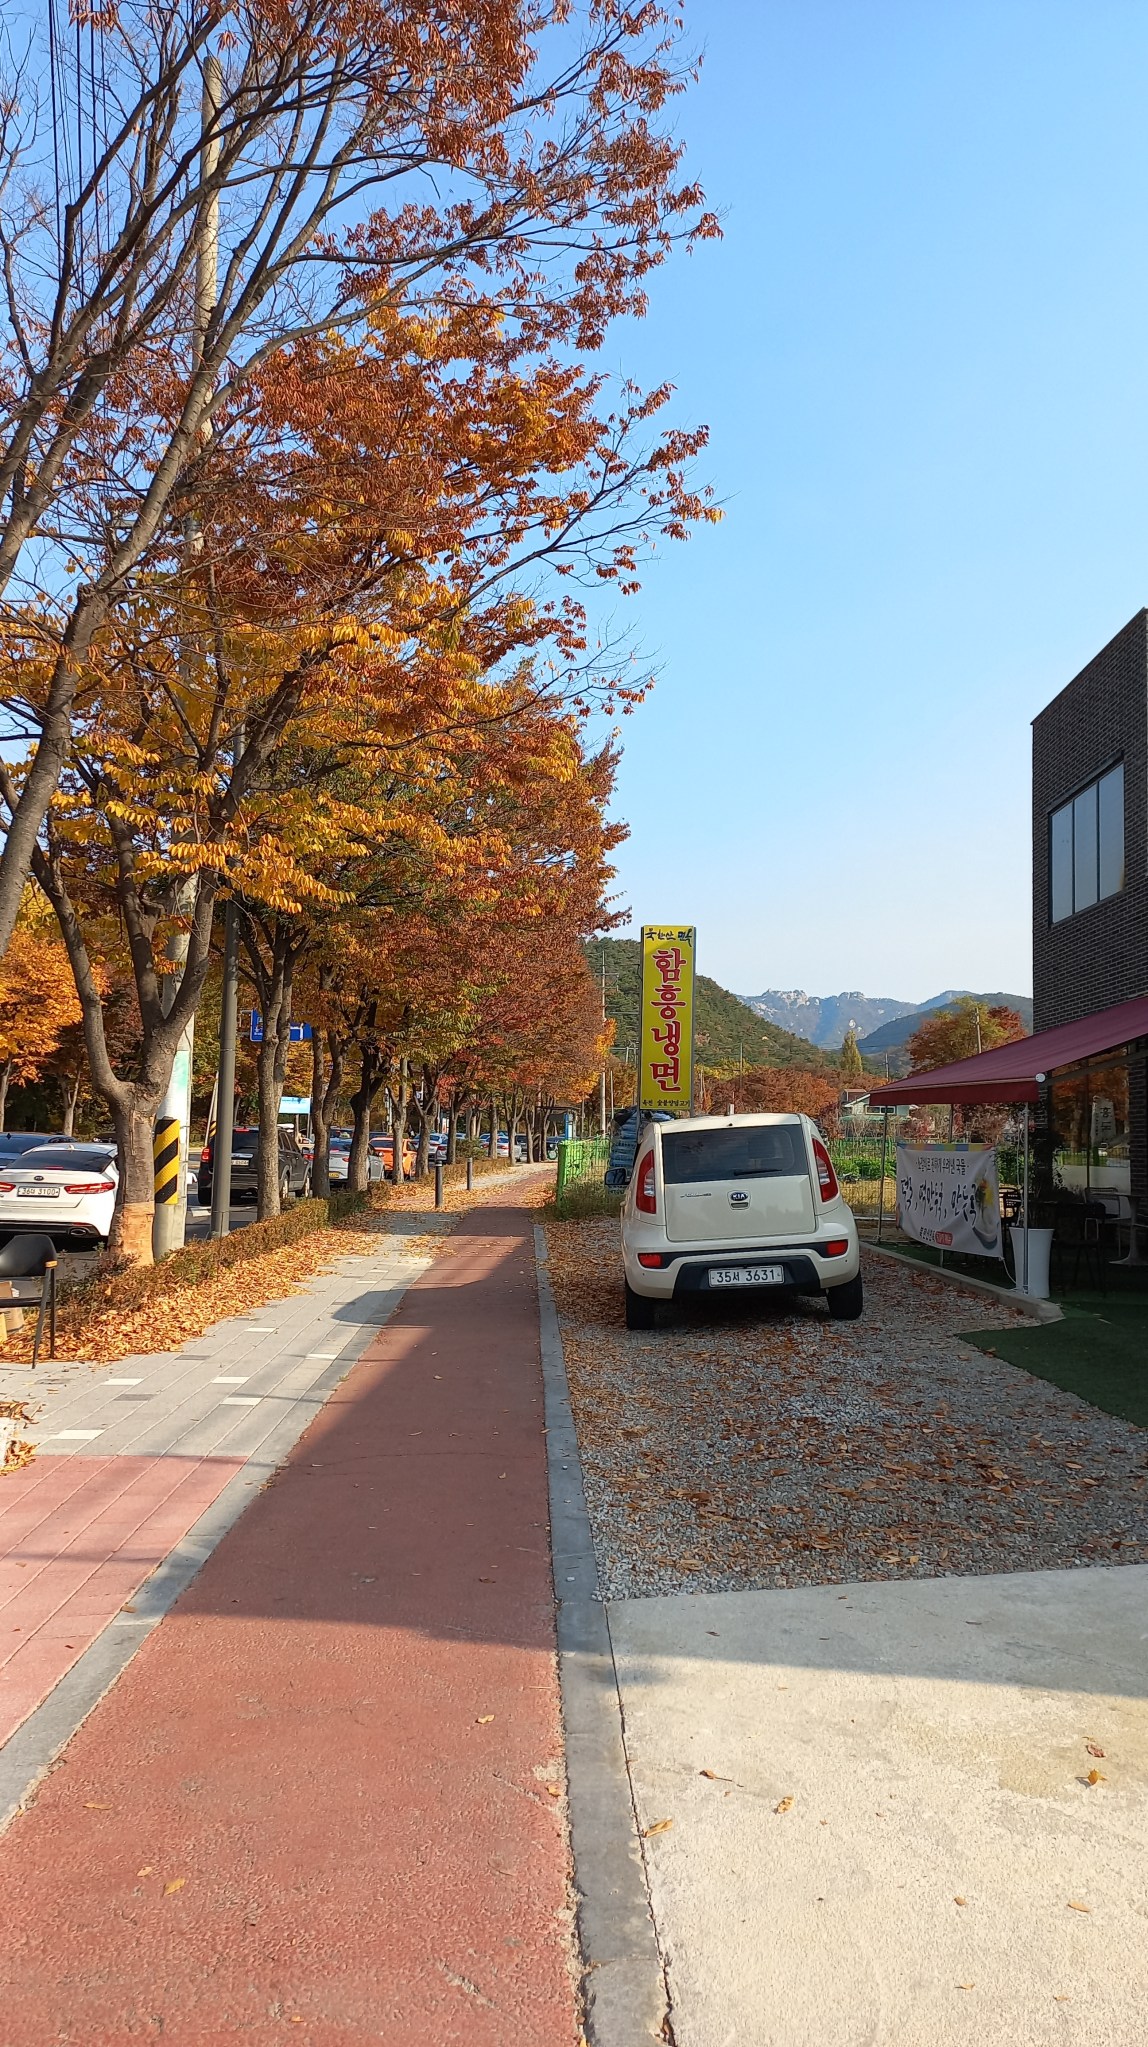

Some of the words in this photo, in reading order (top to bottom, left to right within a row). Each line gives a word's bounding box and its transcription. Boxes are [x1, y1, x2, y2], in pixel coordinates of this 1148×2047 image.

[645, 928, 676, 941] 북한산
[678, 928, 693, 947] 면옥
[650, 947, 687, 1093] 함흥냉면
[956, 1158, 967, 1176] 국물
[716, 1271, 740, 1283] 35서
[746, 1269, 775, 1282] 3631
